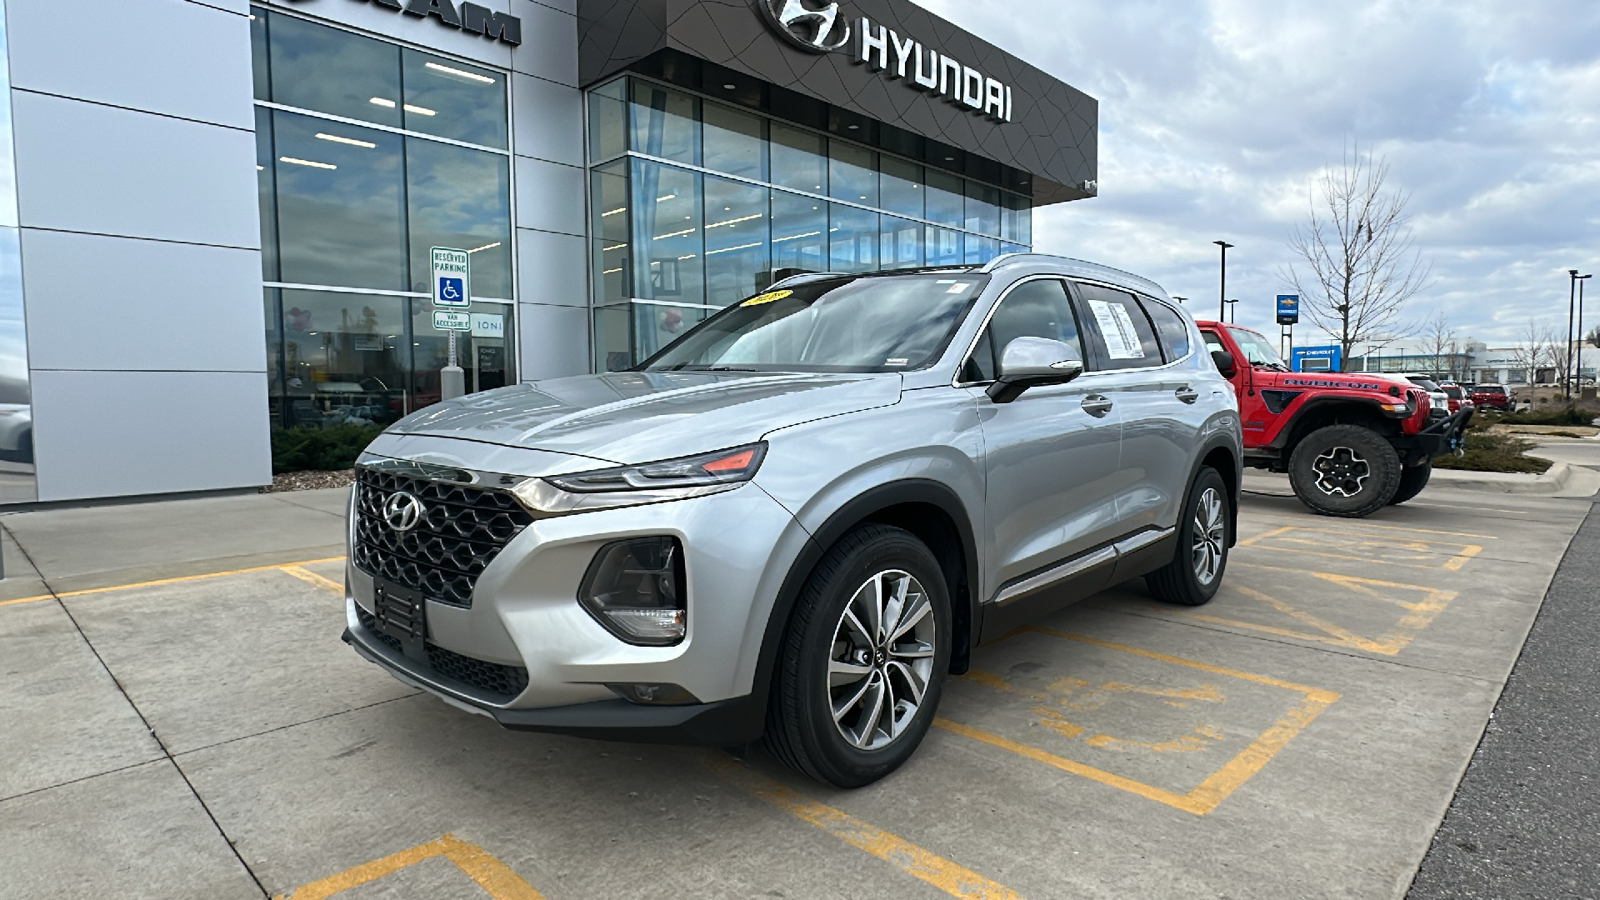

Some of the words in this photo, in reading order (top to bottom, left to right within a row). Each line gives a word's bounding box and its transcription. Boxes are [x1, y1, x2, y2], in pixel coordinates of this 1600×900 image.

[374, 0, 522, 46] AM
[860, 16, 1012, 123] HYUNDAI
[434, 252, 466, 263] RESERVED
[434, 263, 467, 273] PARKING
[436, 320, 469, 328] ACCESSIBLE
[1283, 379, 1380, 390] RUBICON
